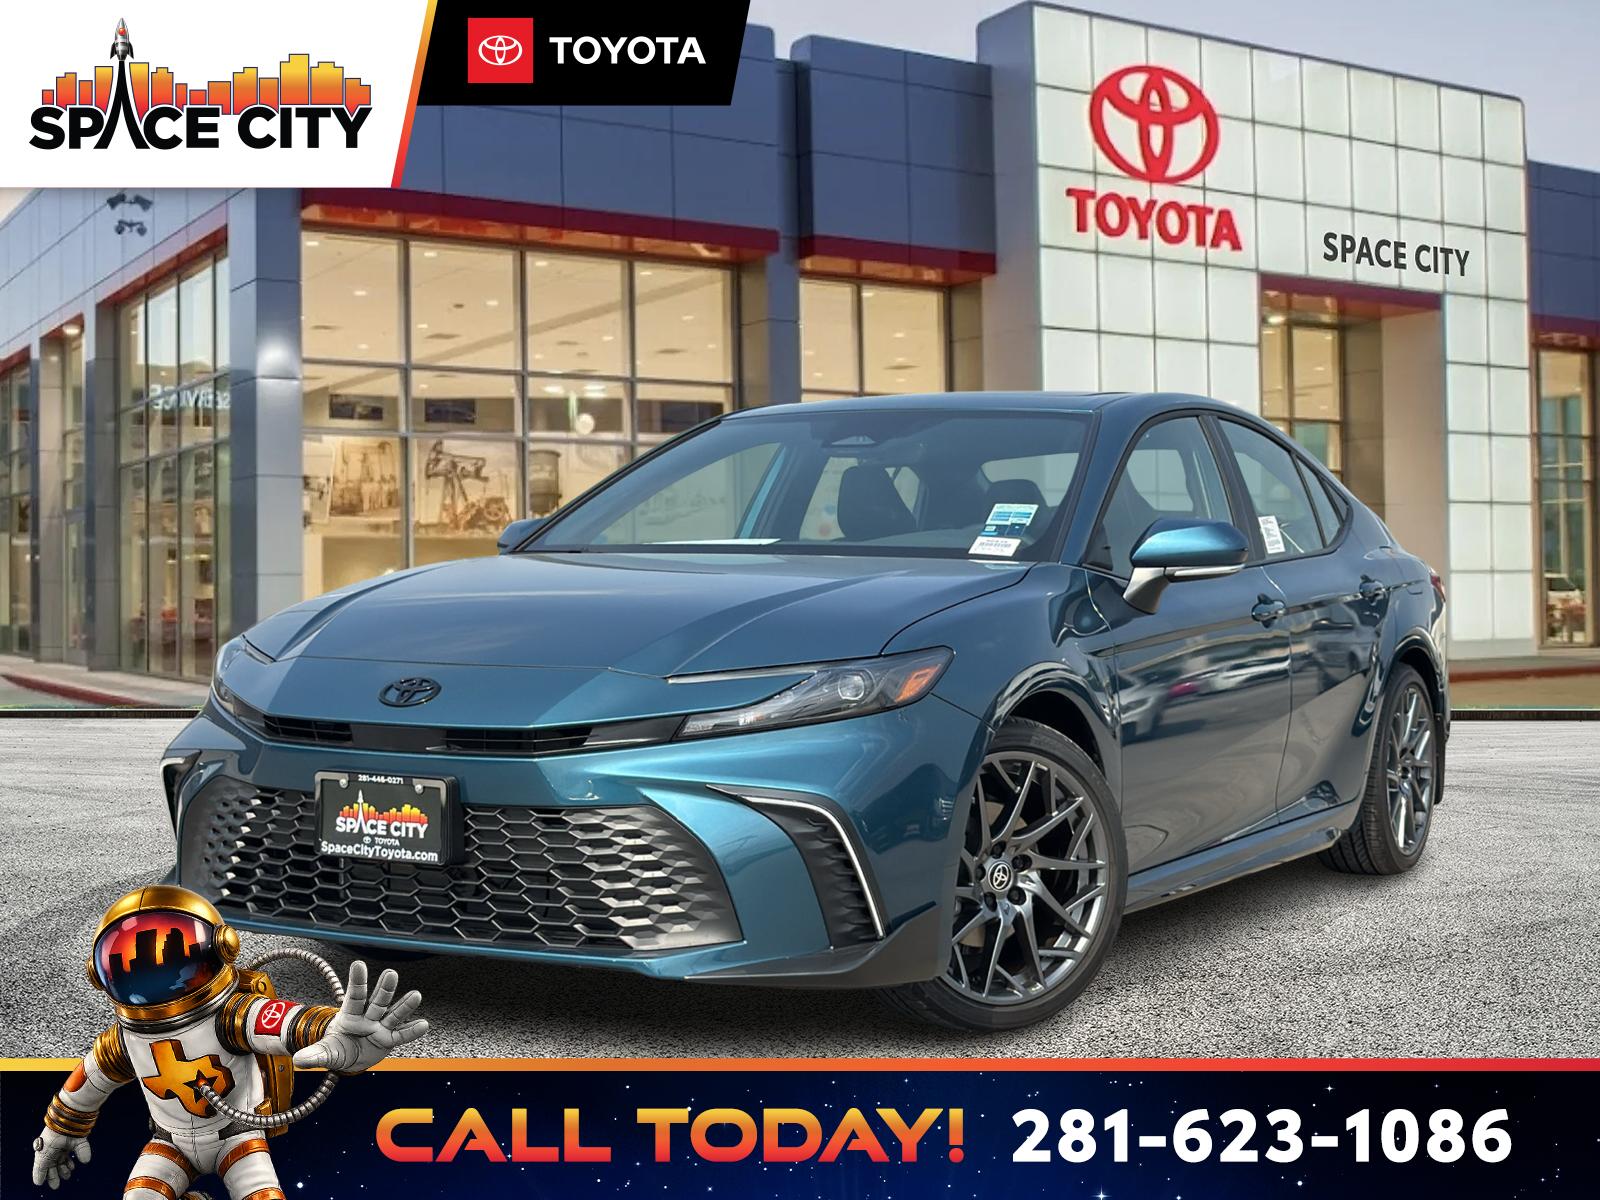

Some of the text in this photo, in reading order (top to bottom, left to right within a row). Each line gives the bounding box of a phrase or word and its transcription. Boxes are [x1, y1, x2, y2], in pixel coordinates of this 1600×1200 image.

[1066, 187, 1242, 251] TOYOTA
[1323, 232, 1470, 277] SPACE CITY
[336, 808, 429, 839] SPACE CITY
[321, 841, 438, 862] SpaceCityToyota.com
[374, 837, 400, 847] TOYOTA
